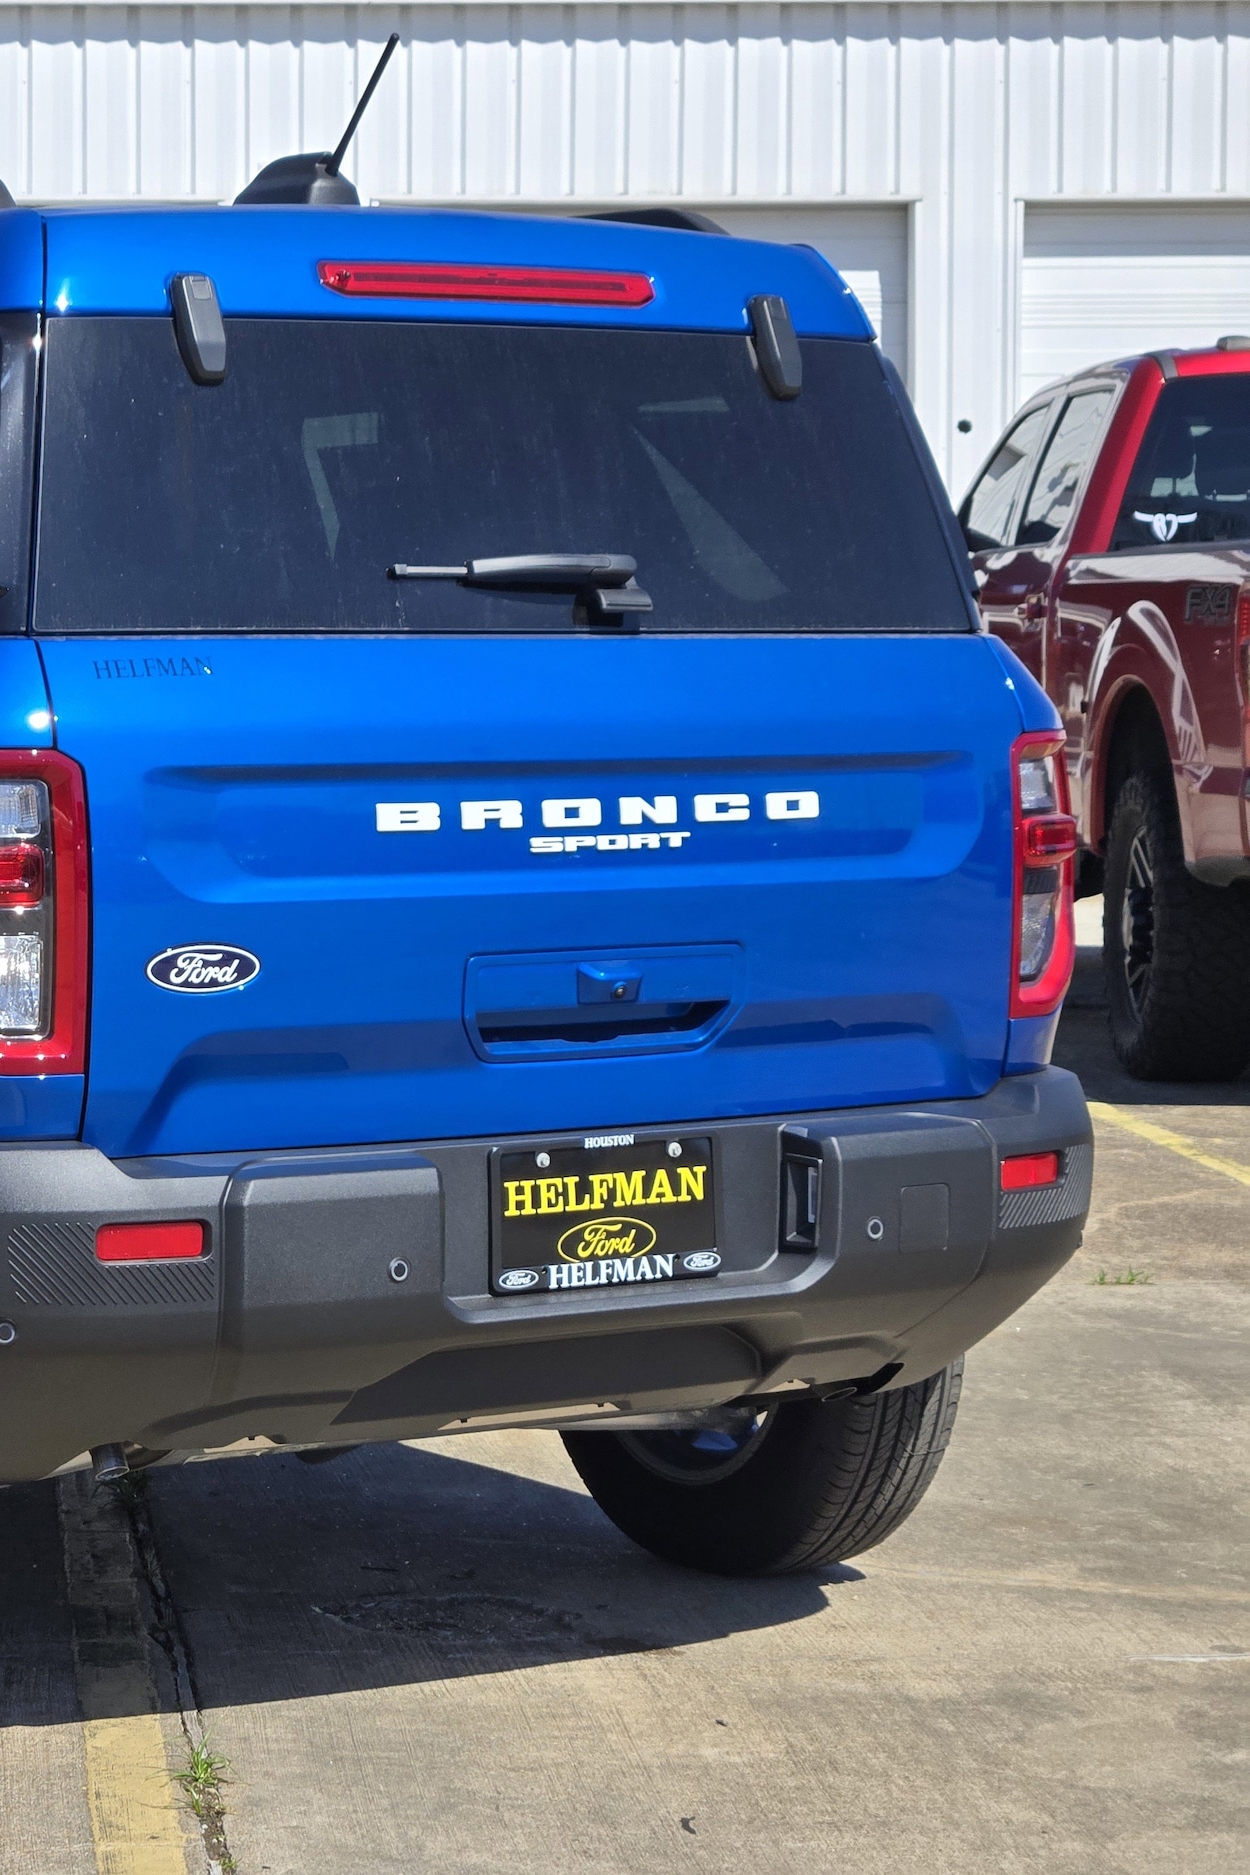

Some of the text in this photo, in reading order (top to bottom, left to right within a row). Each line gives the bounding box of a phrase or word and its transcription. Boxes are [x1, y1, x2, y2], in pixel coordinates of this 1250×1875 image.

[92, 656, 214, 680] HELFMAN
[375, 791, 820, 832] BRONCO
[529, 831, 691, 853] SPORT
[169, 952, 241, 984] Ford
[584, 1134, 635, 1149] HOUSTON
[503, 1165, 707, 1218] HELFMAN
[577, 1223, 637, 1258] Ford
[548, 1253, 675, 1290] HELFMAN
